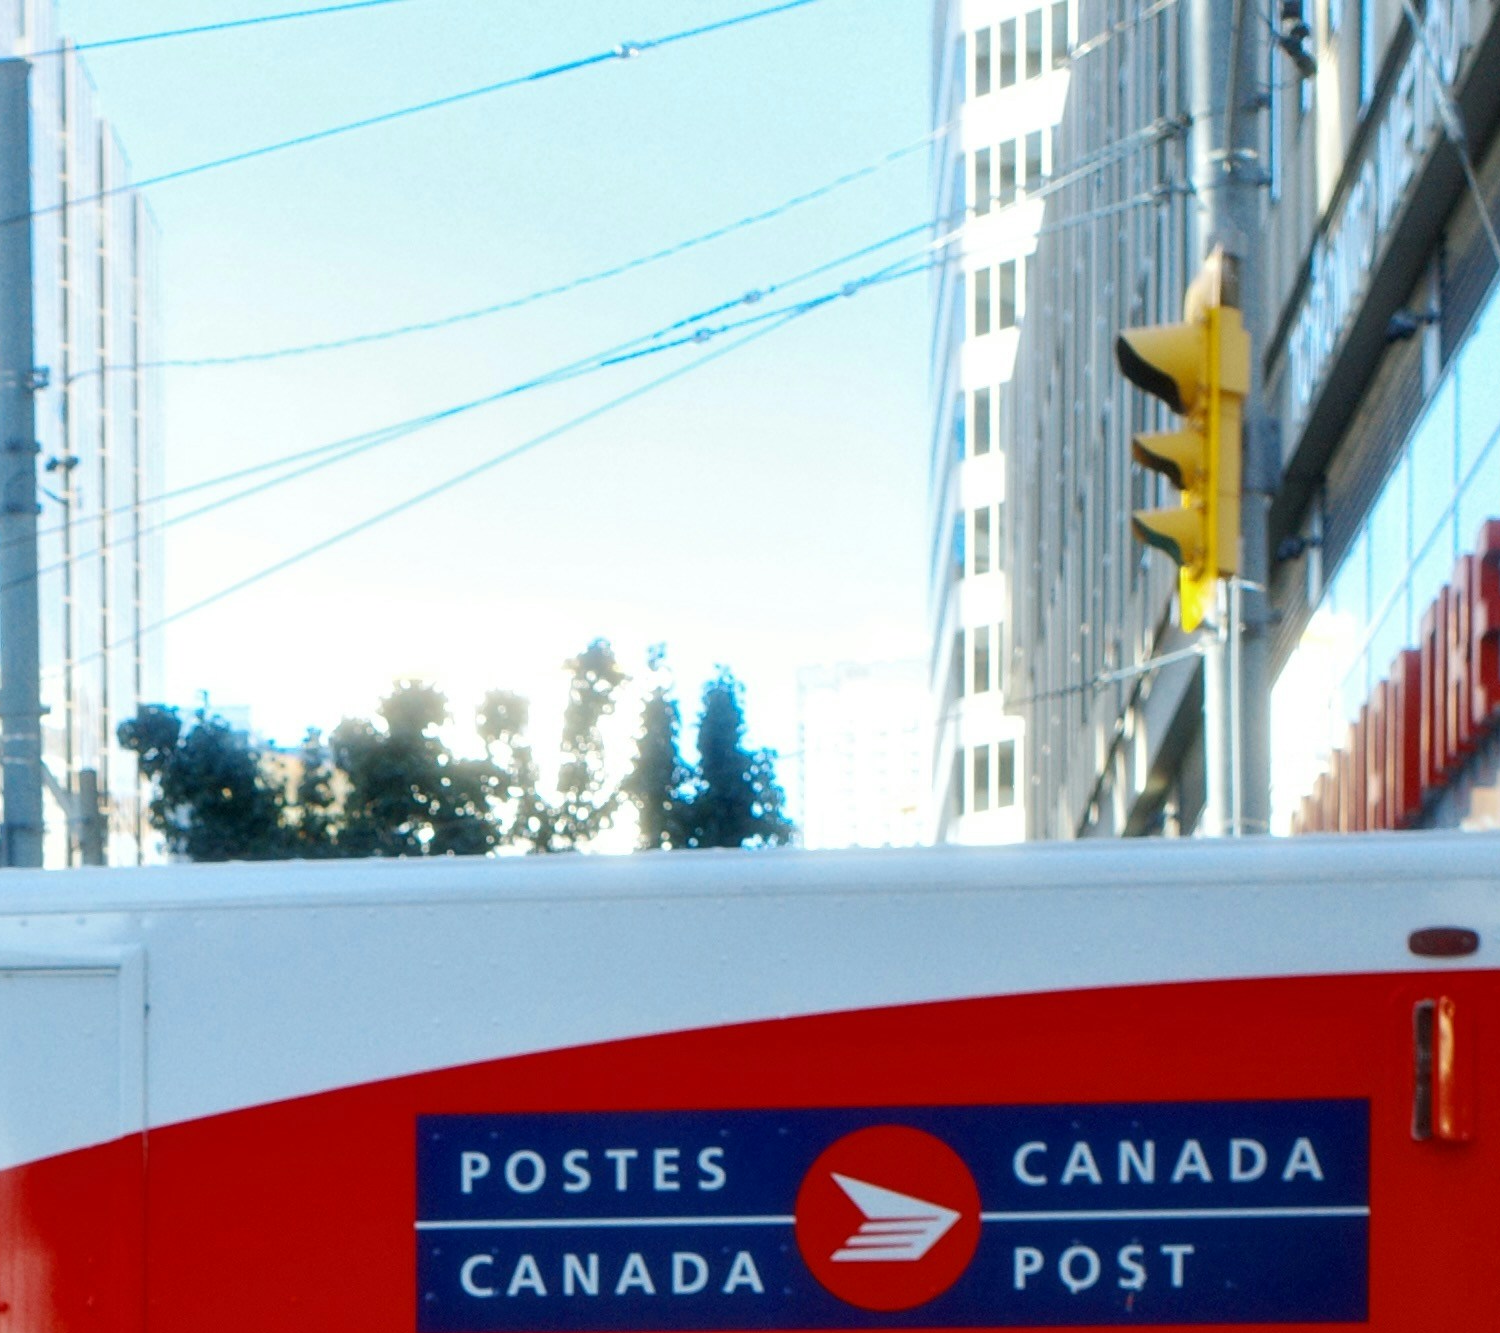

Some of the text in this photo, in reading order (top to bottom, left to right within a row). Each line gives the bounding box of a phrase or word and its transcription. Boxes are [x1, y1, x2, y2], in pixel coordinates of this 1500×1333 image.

[459, 1146, 729, 1194] POSTES
[1011, 1136, 1326, 1187] CANADA
[458, 1249, 767, 1299] CANADA
[1012, 1243, 1197, 1291] POST
